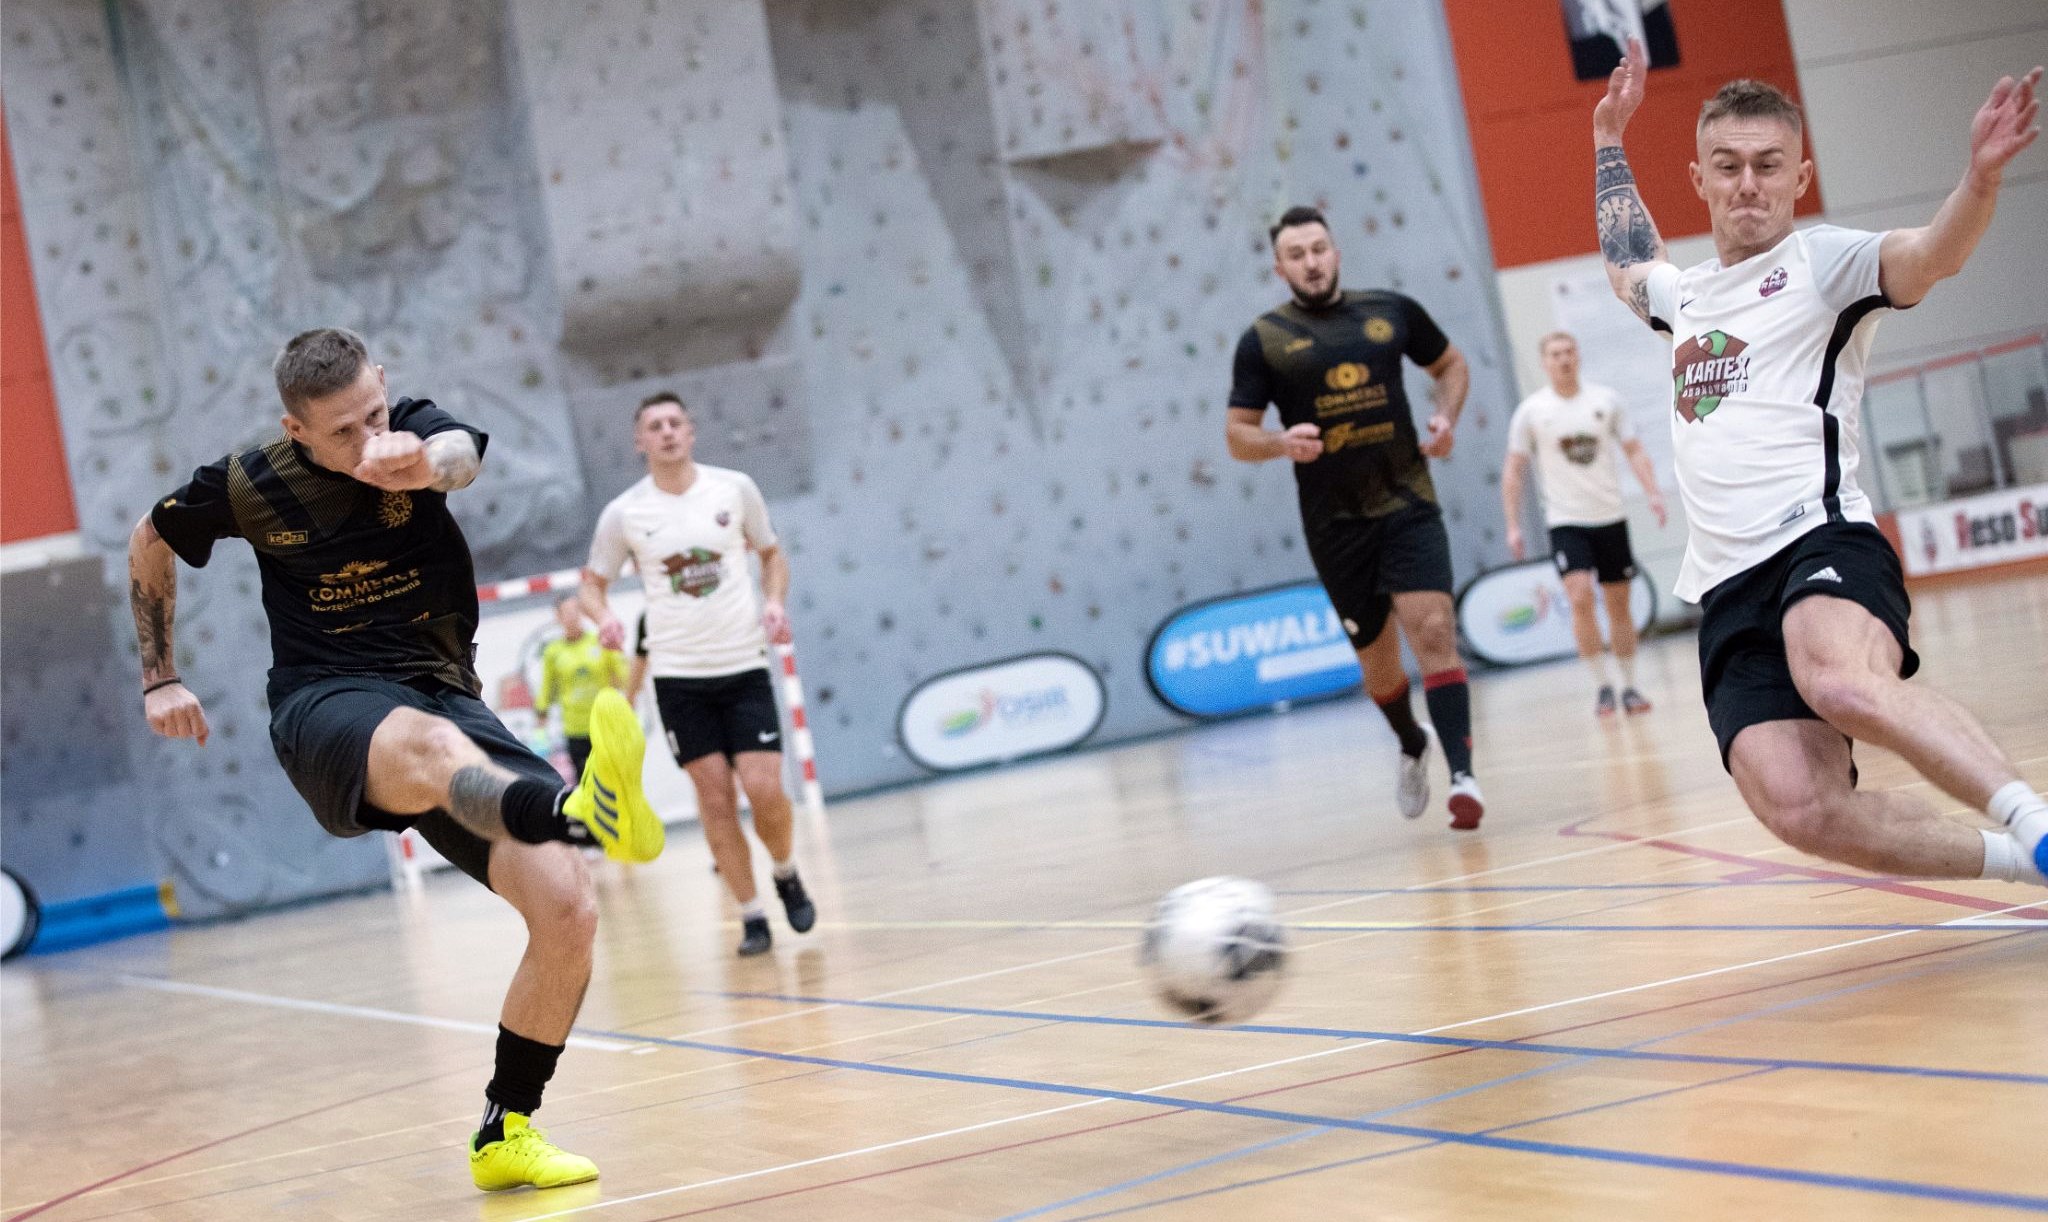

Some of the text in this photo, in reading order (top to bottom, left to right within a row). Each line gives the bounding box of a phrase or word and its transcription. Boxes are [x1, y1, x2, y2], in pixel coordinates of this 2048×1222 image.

[1684, 356, 1750, 387] KARTEX
[367, 594, 382, 603] do
[383, 579, 421, 598] drewna
